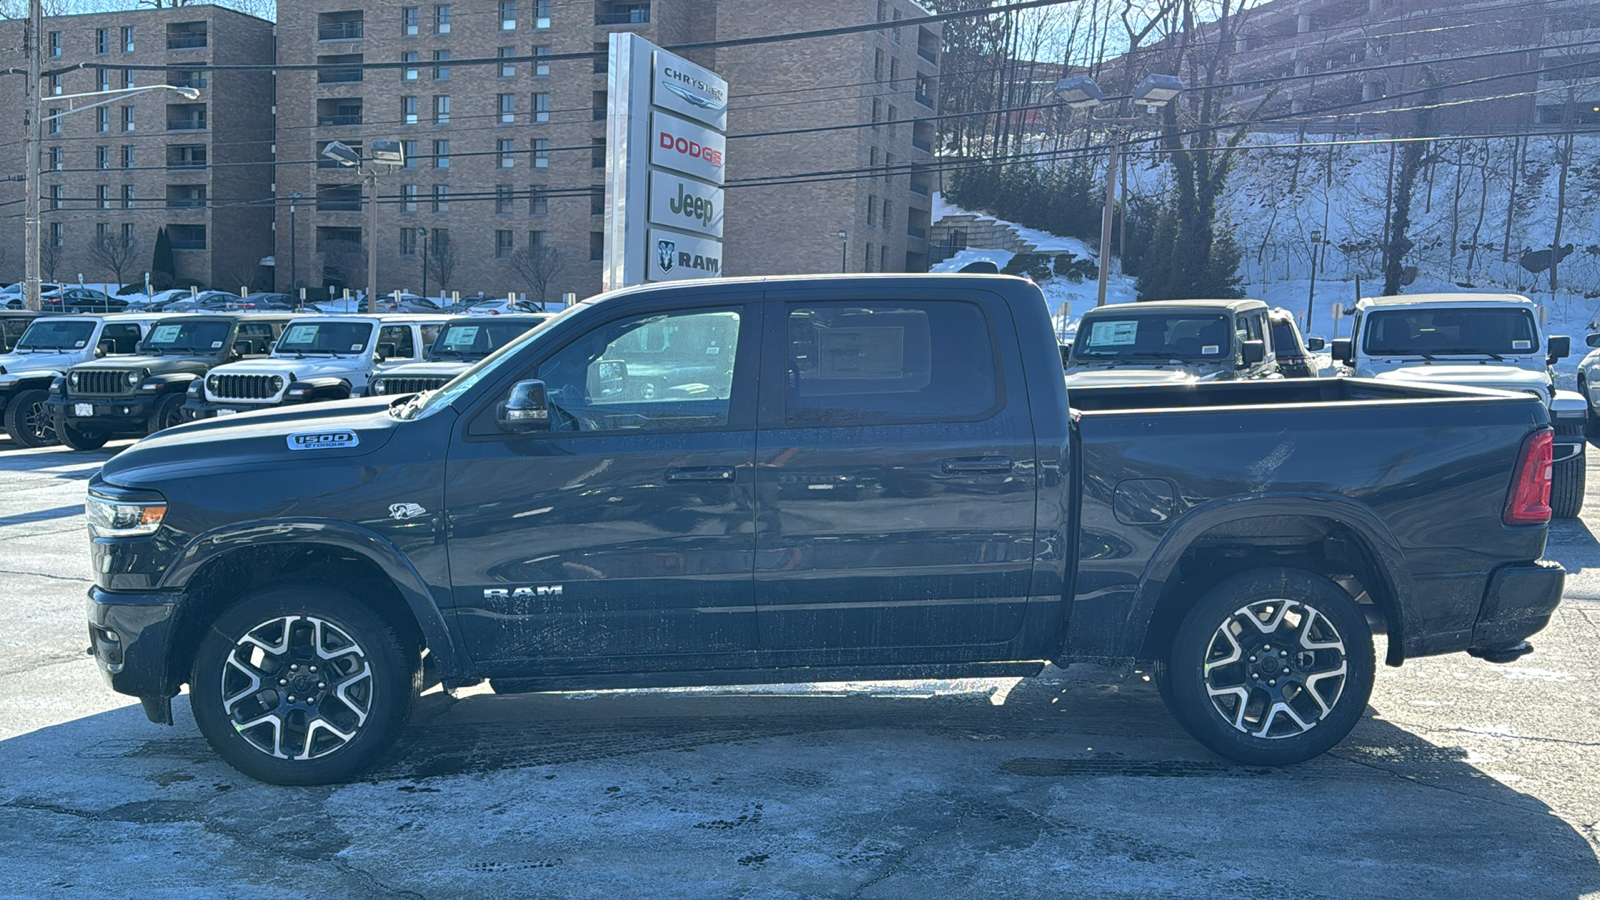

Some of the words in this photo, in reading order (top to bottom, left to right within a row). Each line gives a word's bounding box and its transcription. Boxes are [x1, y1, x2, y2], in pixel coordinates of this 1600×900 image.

[664, 67, 724, 100] CHRYSLER
[659, 131, 722, 166] DODGE
[669, 183, 713, 227] Jeep
[678, 251, 719, 273] RAM
[298, 433, 349, 444] 1500
[483, 585, 563, 598] RAM
